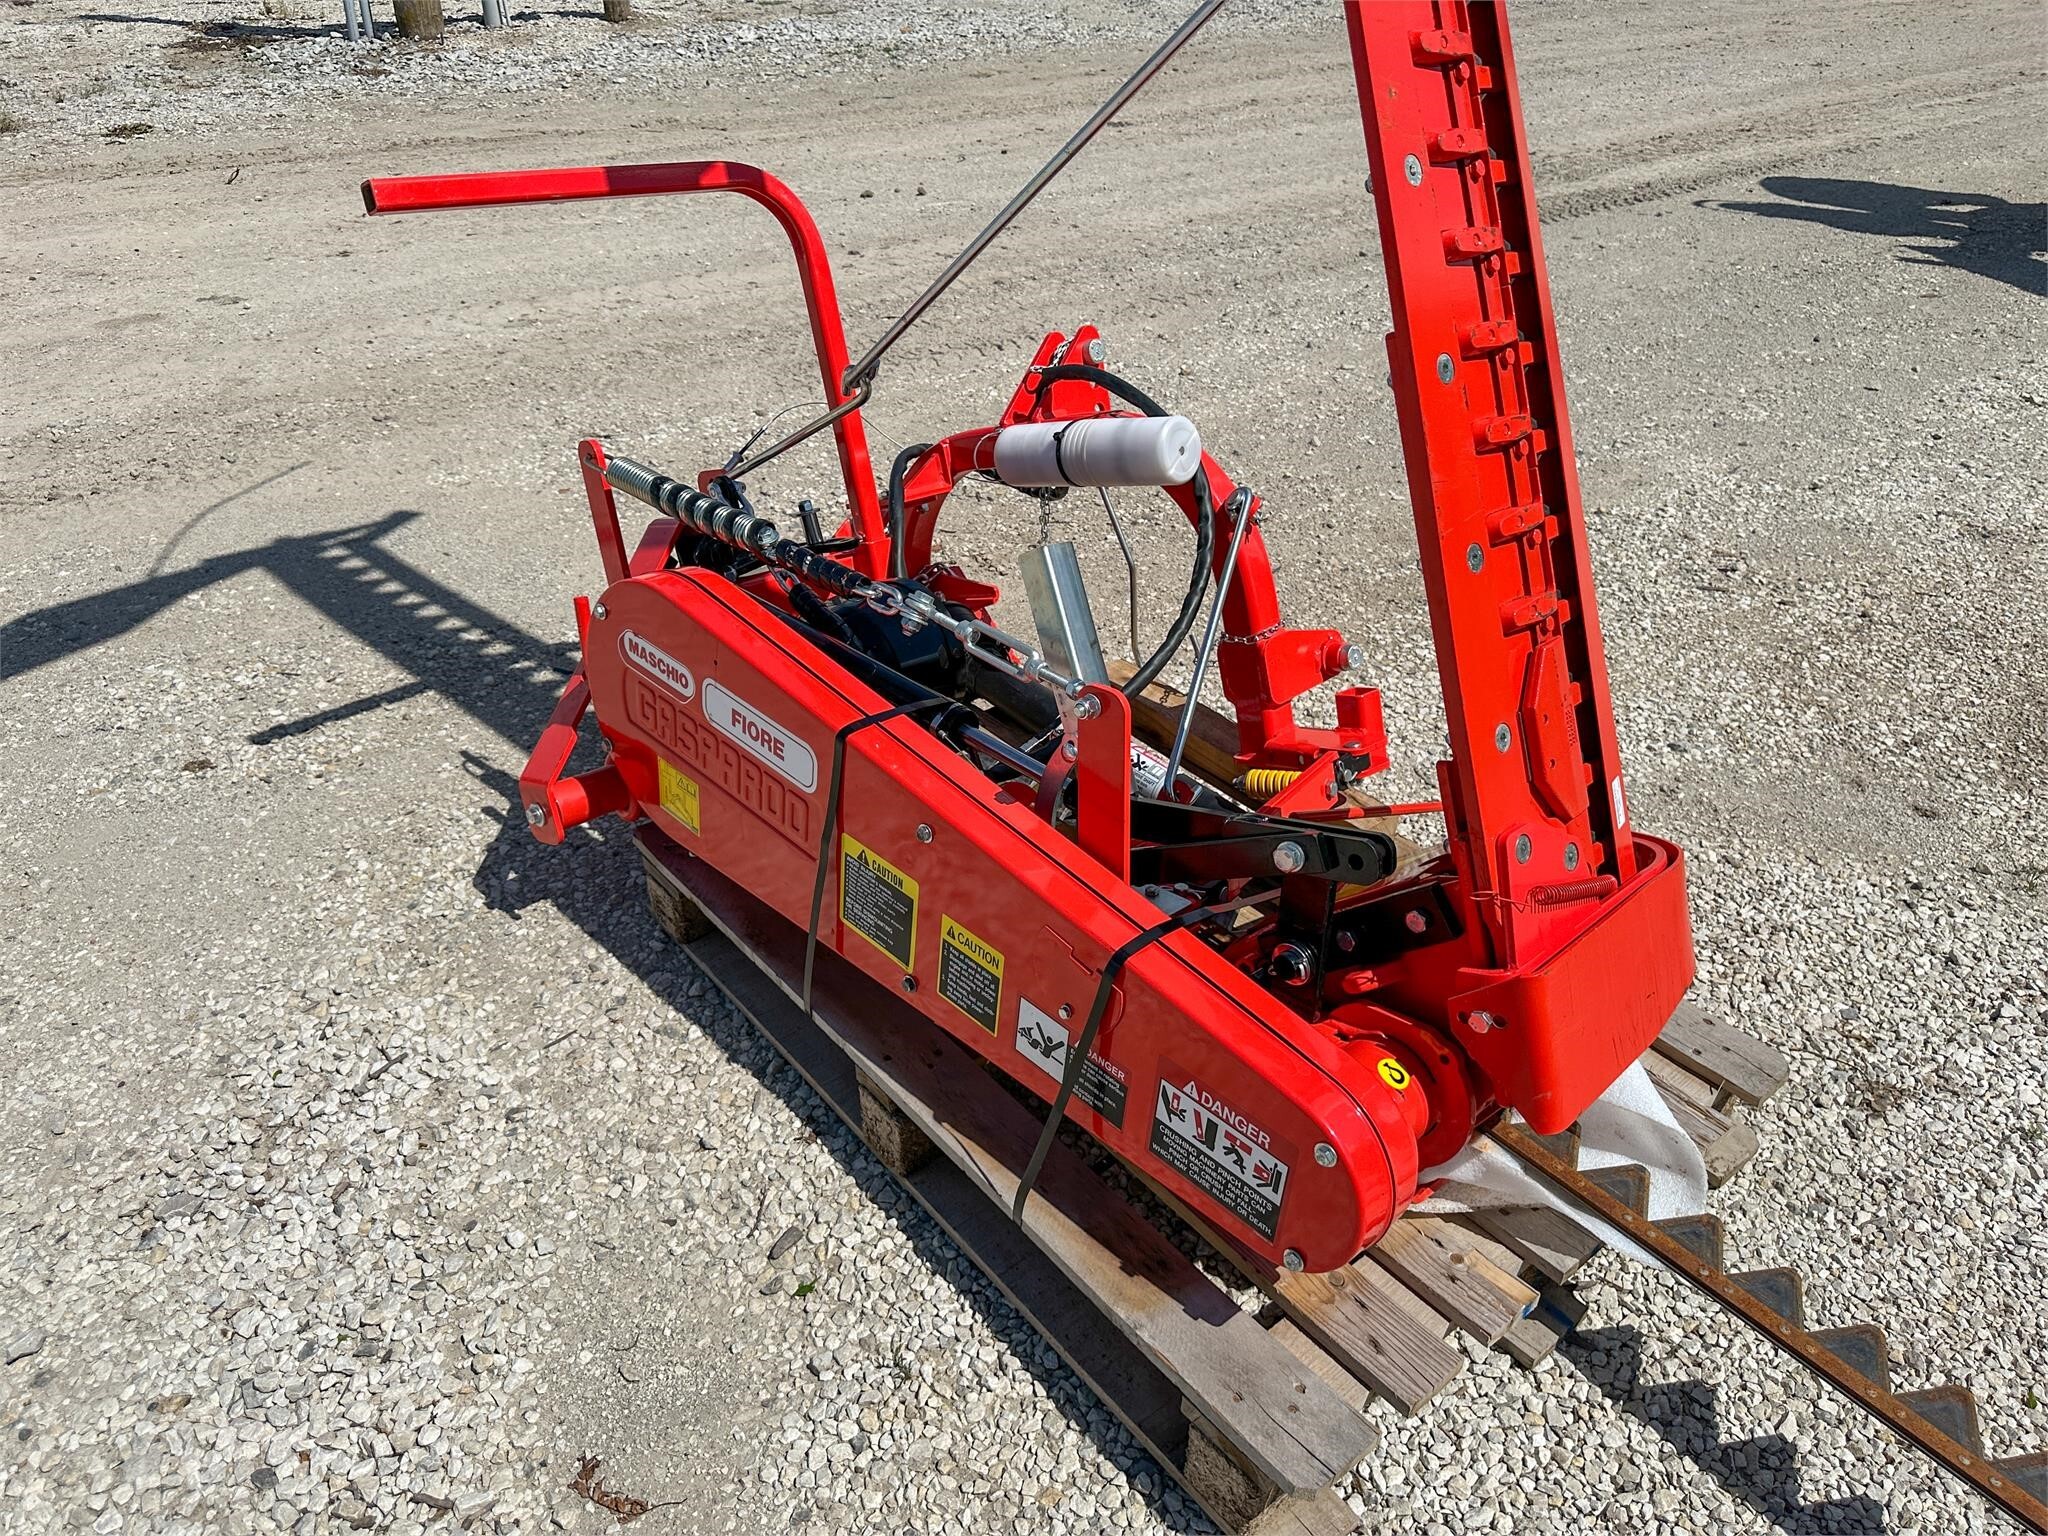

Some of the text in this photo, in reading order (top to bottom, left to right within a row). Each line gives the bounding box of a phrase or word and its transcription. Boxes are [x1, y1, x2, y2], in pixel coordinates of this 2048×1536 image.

[628, 637, 689, 690] MASCHIO
[636, 680, 809, 843] GASPARDO
[731, 707, 785, 762] FIORE
[871, 859, 904, 890] CAUTION
[957, 932, 1000, 970] CAUTION
[1201, 1091, 1271, 1150] DANGER
[1151, 1141, 1172, 1161] WHICH
[1174, 1158, 1187, 1172] MAY
[1188, 1169, 1210, 1190] CAUSE
[1212, 1186, 1235, 1208] INJURY
[1236, 1204, 1247, 1217] OR
[1159, 1123, 1272, 1211] CRUSHING AND PINCH POINTS
[1162, 1135, 1265, 1214] MOVING MACHINERY PARTS CAN
[1168, 1146, 1187, 1165] PINCH
[1189, 1162, 1199, 1173] OR
[1200, 1170, 1223, 1192] CRUSH
[1225, 1188, 1235, 1200] OR
